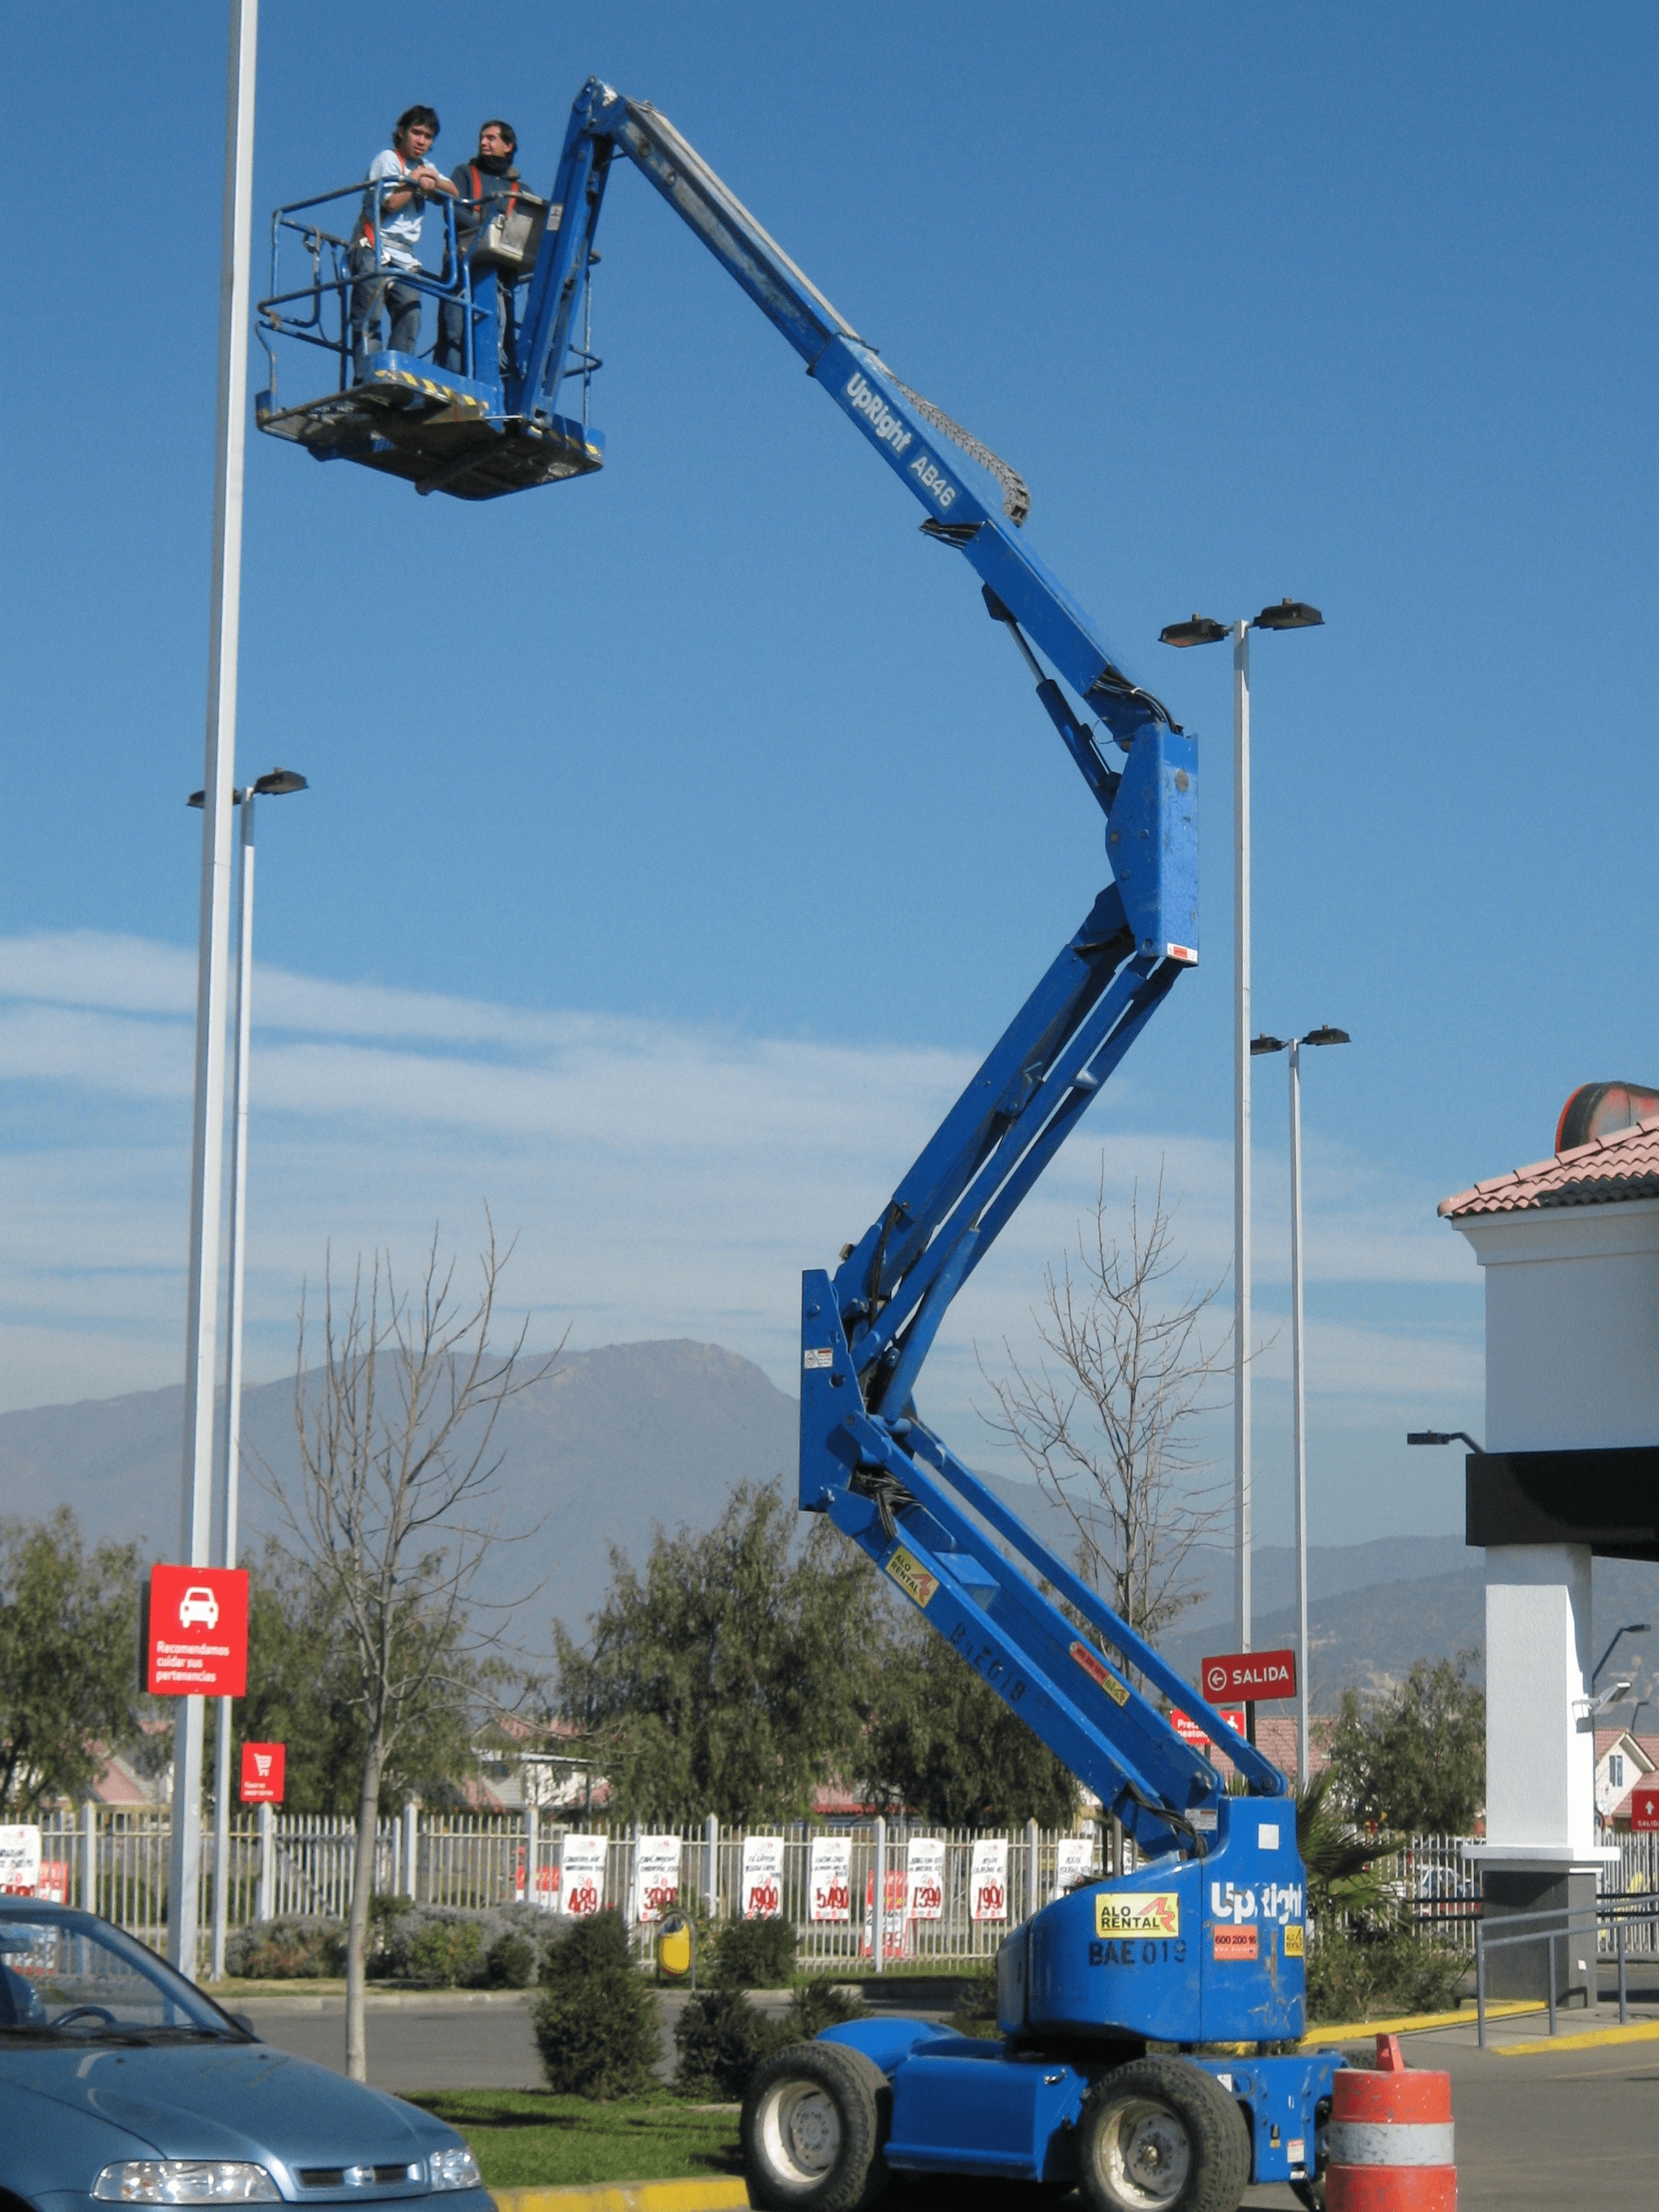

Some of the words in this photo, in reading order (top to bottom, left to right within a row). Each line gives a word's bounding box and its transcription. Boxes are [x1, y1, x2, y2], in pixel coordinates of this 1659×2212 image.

[847, 372, 912, 453] UpRight
[910, 455, 957, 507] AB46
[895, 1554, 911, 1572] ALO
[890, 1561, 919, 1594] RENTAL
[156, 1640, 230, 1656] Recomendamos
[156, 1655, 186, 1668] cuidar
[186, 1658, 203, 1669] sus
[156, 1670, 217, 1683] pertenencias
[1232, 1664, 1290, 1686] SALIDA
[1637, 1819, 1659, 1827] SALID
[1101, 1906, 1131, 1917] ALO
[1101, 1917, 1160, 1929] RENTAL
[1215, 1935, 1231, 1945] 600
[1232, 1935, 1247, 1945] 200
[1089, 1940, 1136, 1967] BAE
